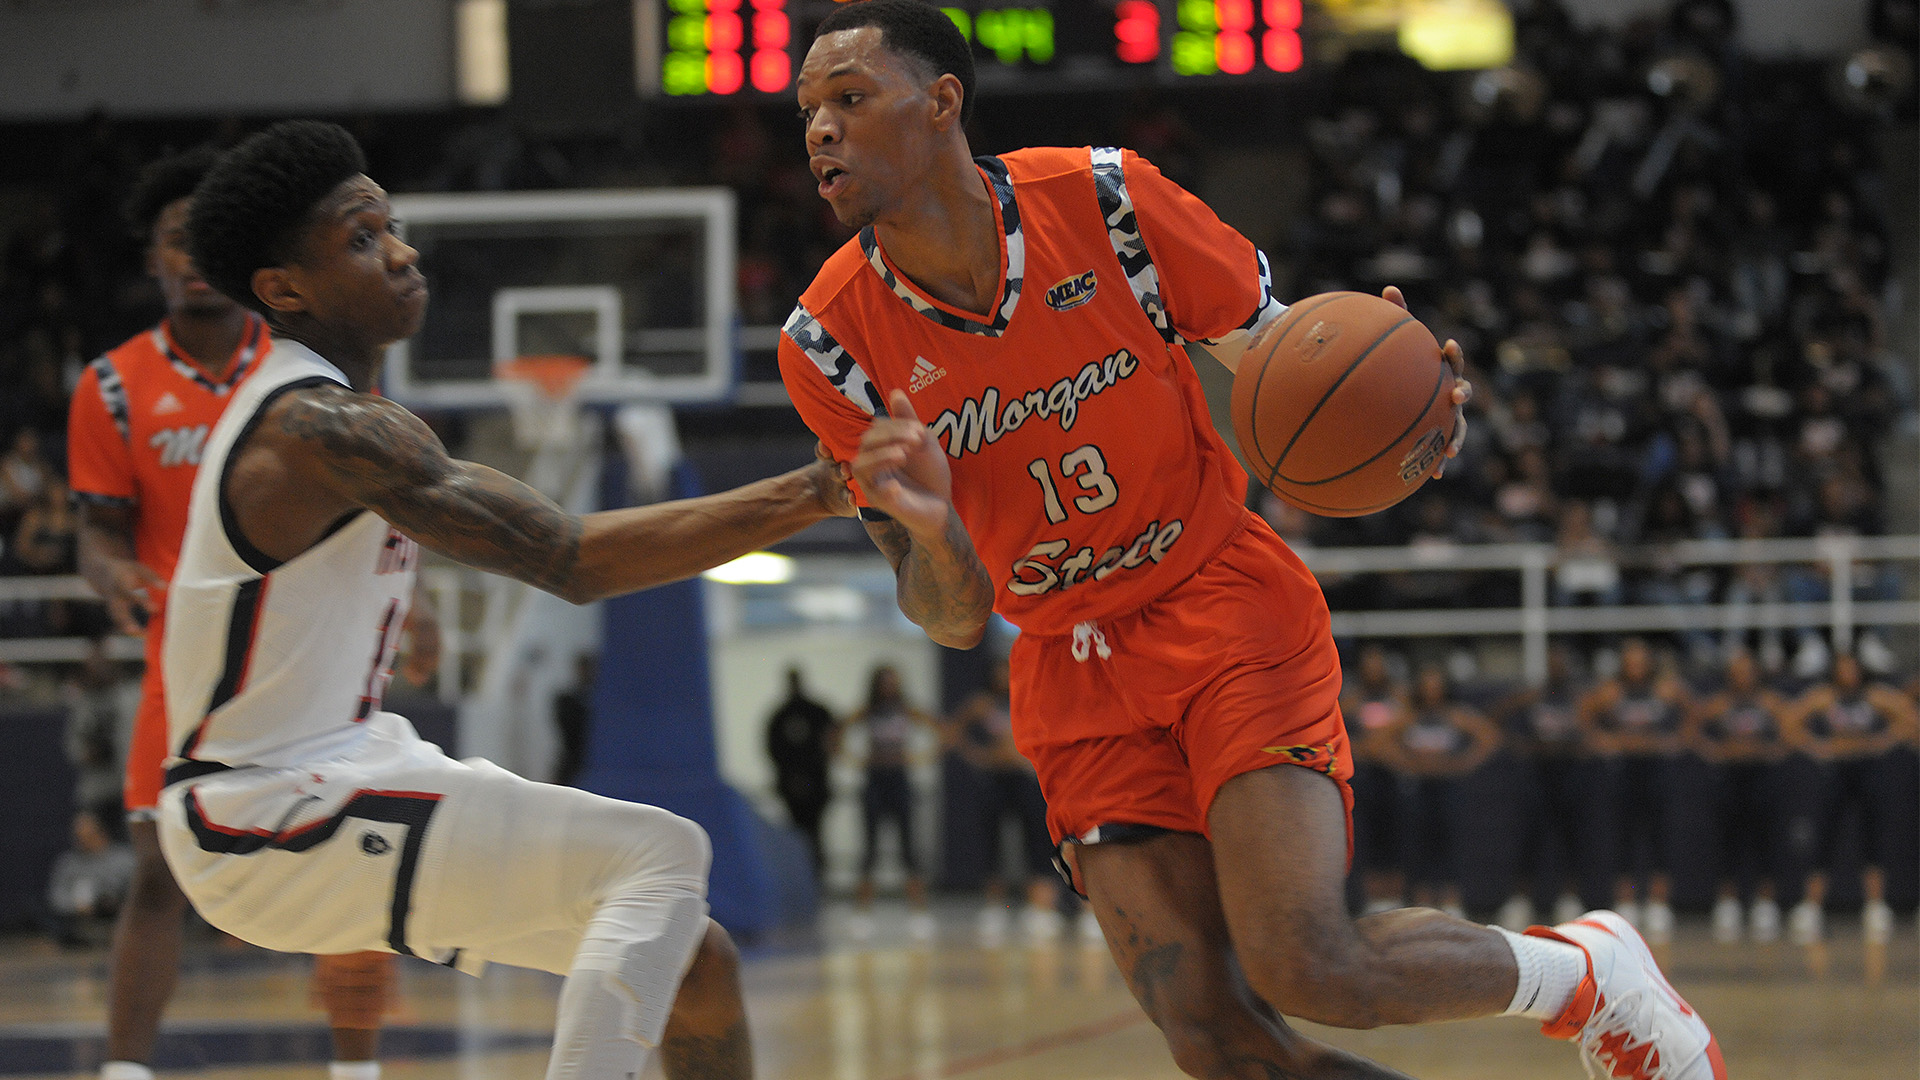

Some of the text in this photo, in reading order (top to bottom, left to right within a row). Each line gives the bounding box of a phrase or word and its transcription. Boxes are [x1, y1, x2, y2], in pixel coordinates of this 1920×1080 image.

[1047, 270, 1096, 307] MEAC
[909, 367, 947, 394] adidas
[927, 348, 1139, 459] Morgan
[1027, 444, 1119, 525] 13
[1006, 519, 1184, 597] State
